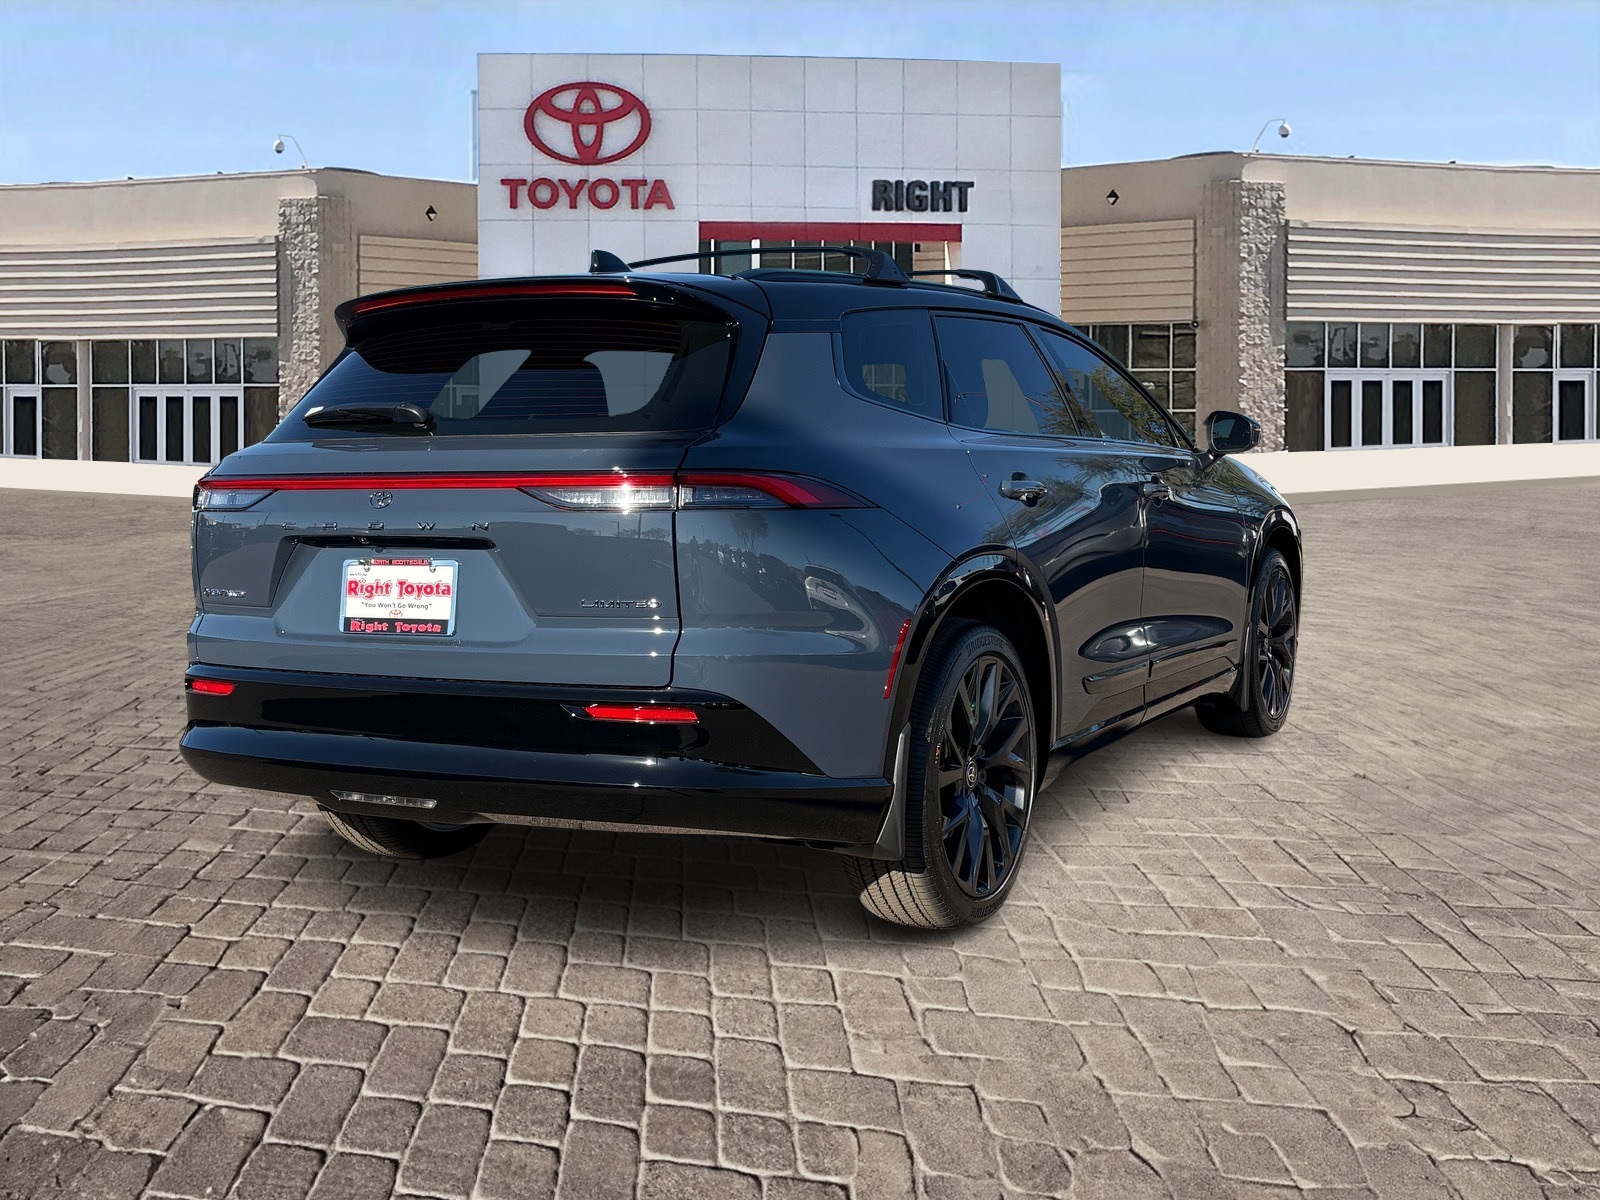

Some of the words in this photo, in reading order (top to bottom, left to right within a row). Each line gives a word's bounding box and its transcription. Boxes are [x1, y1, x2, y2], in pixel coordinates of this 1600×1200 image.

[500, 177, 675, 210] TOYOTA
[871, 179, 975, 213] RIGHT
[282, 521, 490, 532] CROWN
[347, 579, 392, 600] Right
[396, 579, 453, 600] Toyota
[581, 598, 662, 609] LIMITED
[350, 620, 388, 633] Right
[395, 621, 442, 633] Toyota
